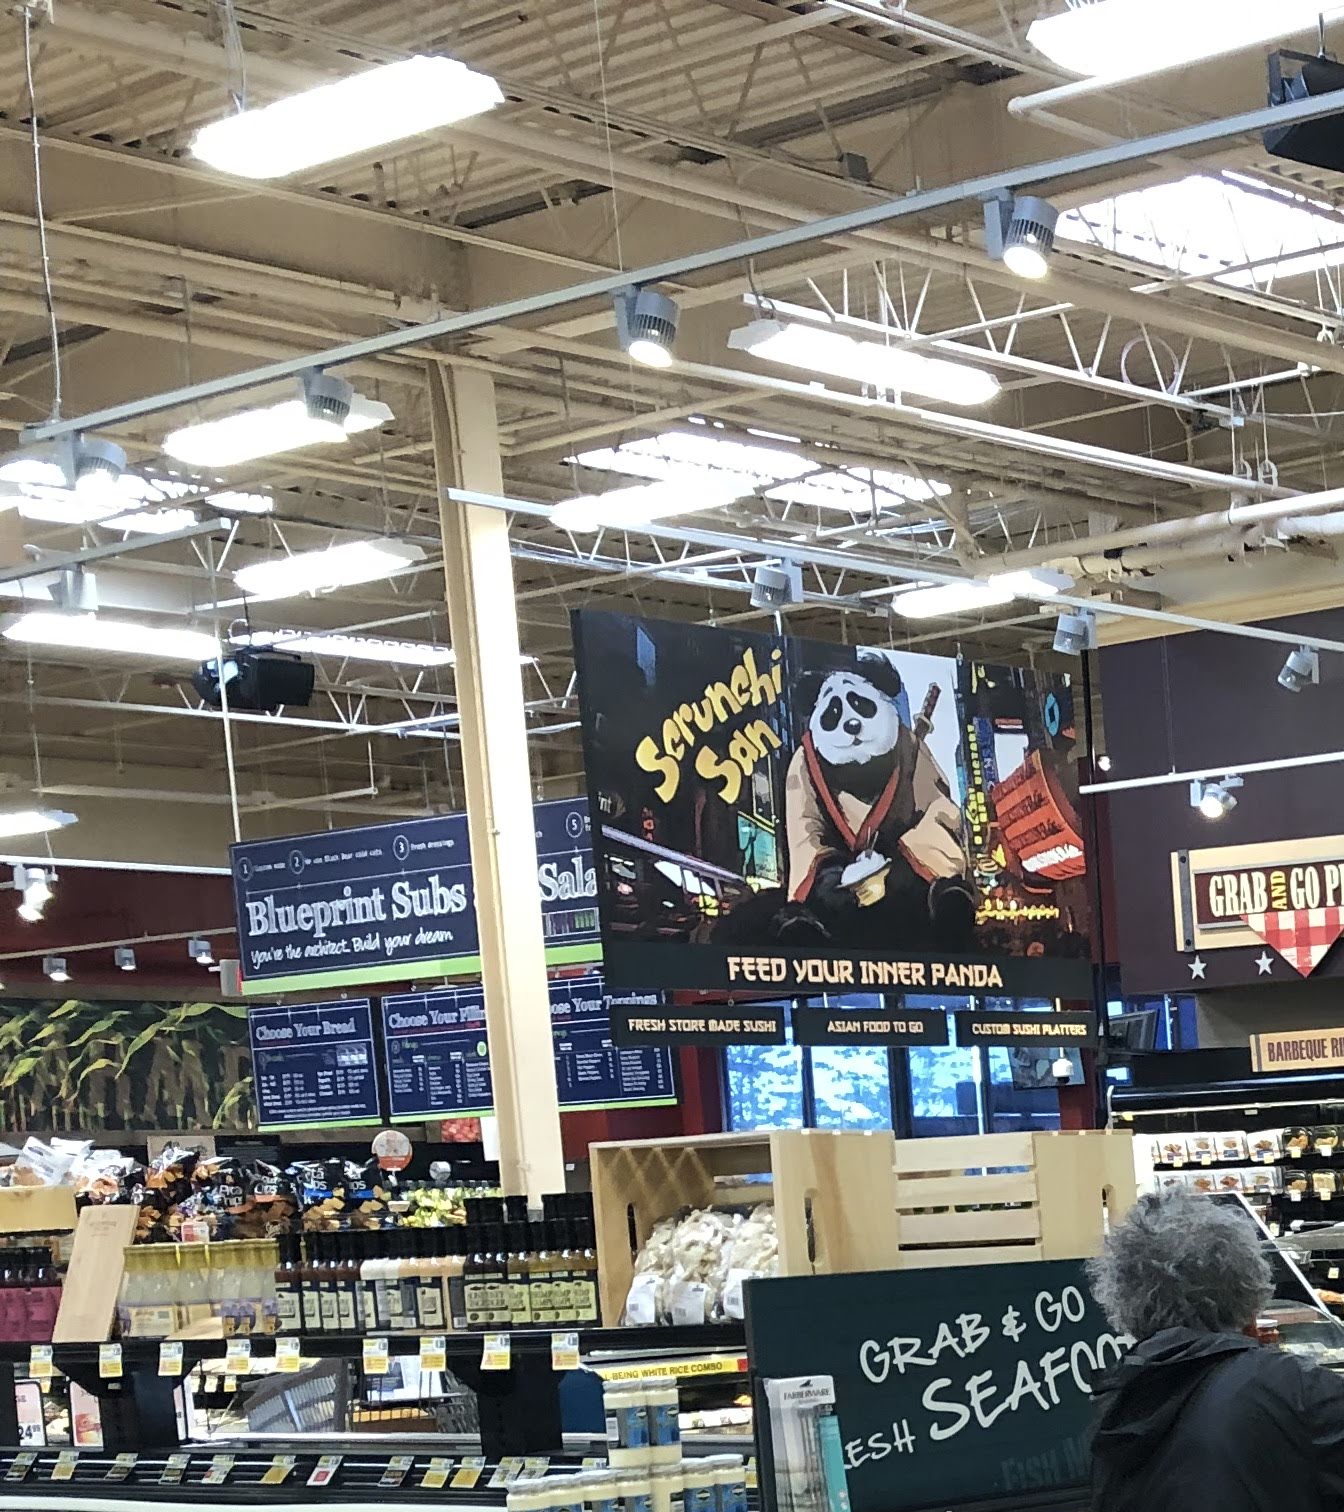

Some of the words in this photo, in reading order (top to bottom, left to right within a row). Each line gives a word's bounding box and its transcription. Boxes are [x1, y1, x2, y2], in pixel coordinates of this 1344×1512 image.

[635, 646, 783, 804] Scrunchi
[696, 716, 782, 804] San
[538, 854, 599, 901] Sala
[1209, 870, 1268, 918] GRAB
[1271, 869, 1289, 911] AND
[1289, 866, 1321, 909] GO
[245, 885, 387, 938] Blueprint
[391, 873, 468, 921] Subs
[285, 944, 302, 959] the
[352, 933, 381, 953] Build
[384, 934, 412, 957] your
[726, 955, 787, 983] FEED
[792, 958, 855, 985] YOUR
[860, 959, 925, 986] INNER
[931, 961, 1003, 989] PANDA
[428, 1009, 458, 1025] Your
[571, 997, 603, 1013] Your
[293, 1022, 322, 1038] Your
[322, 1017, 356, 1035] Bread
[628, 1018, 666, 1032] FRESH
[668, 1018, 706, 1033] STORE
[708, 1019, 741, 1033] MADE
[743, 1019, 777, 1034] SUSHI
[827, 1019, 860, 1034] ASIAN
[862, 1020, 892, 1034] FOOD
[893, 1020, 908, 1034] TO
[909, 1020, 924, 1034] GO
[972, 1021, 1011, 1036] CUSTOM
[1012, 1022, 1040, 1036] SUSHI
[1041, 1022, 1087, 1037] PLATTERS
[1267, 1038, 1328, 1062] BARBEQUE
[858, 1312, 991, 1384] GRAB
[1002, 1304, 1028, 1342] &
[1034, 1285, 1086, 1333] GO
[604, 1370, 639, 1381] L-BEING
[641, 1367, 667, 1378] WHITE
[669, 1365, 689, 1375] RICE
[690, 1361, 723, 1372] COMBO
[921, 1332, 1136, 1441] SEAFO
[843, 1418, 916, 1470] ESH
